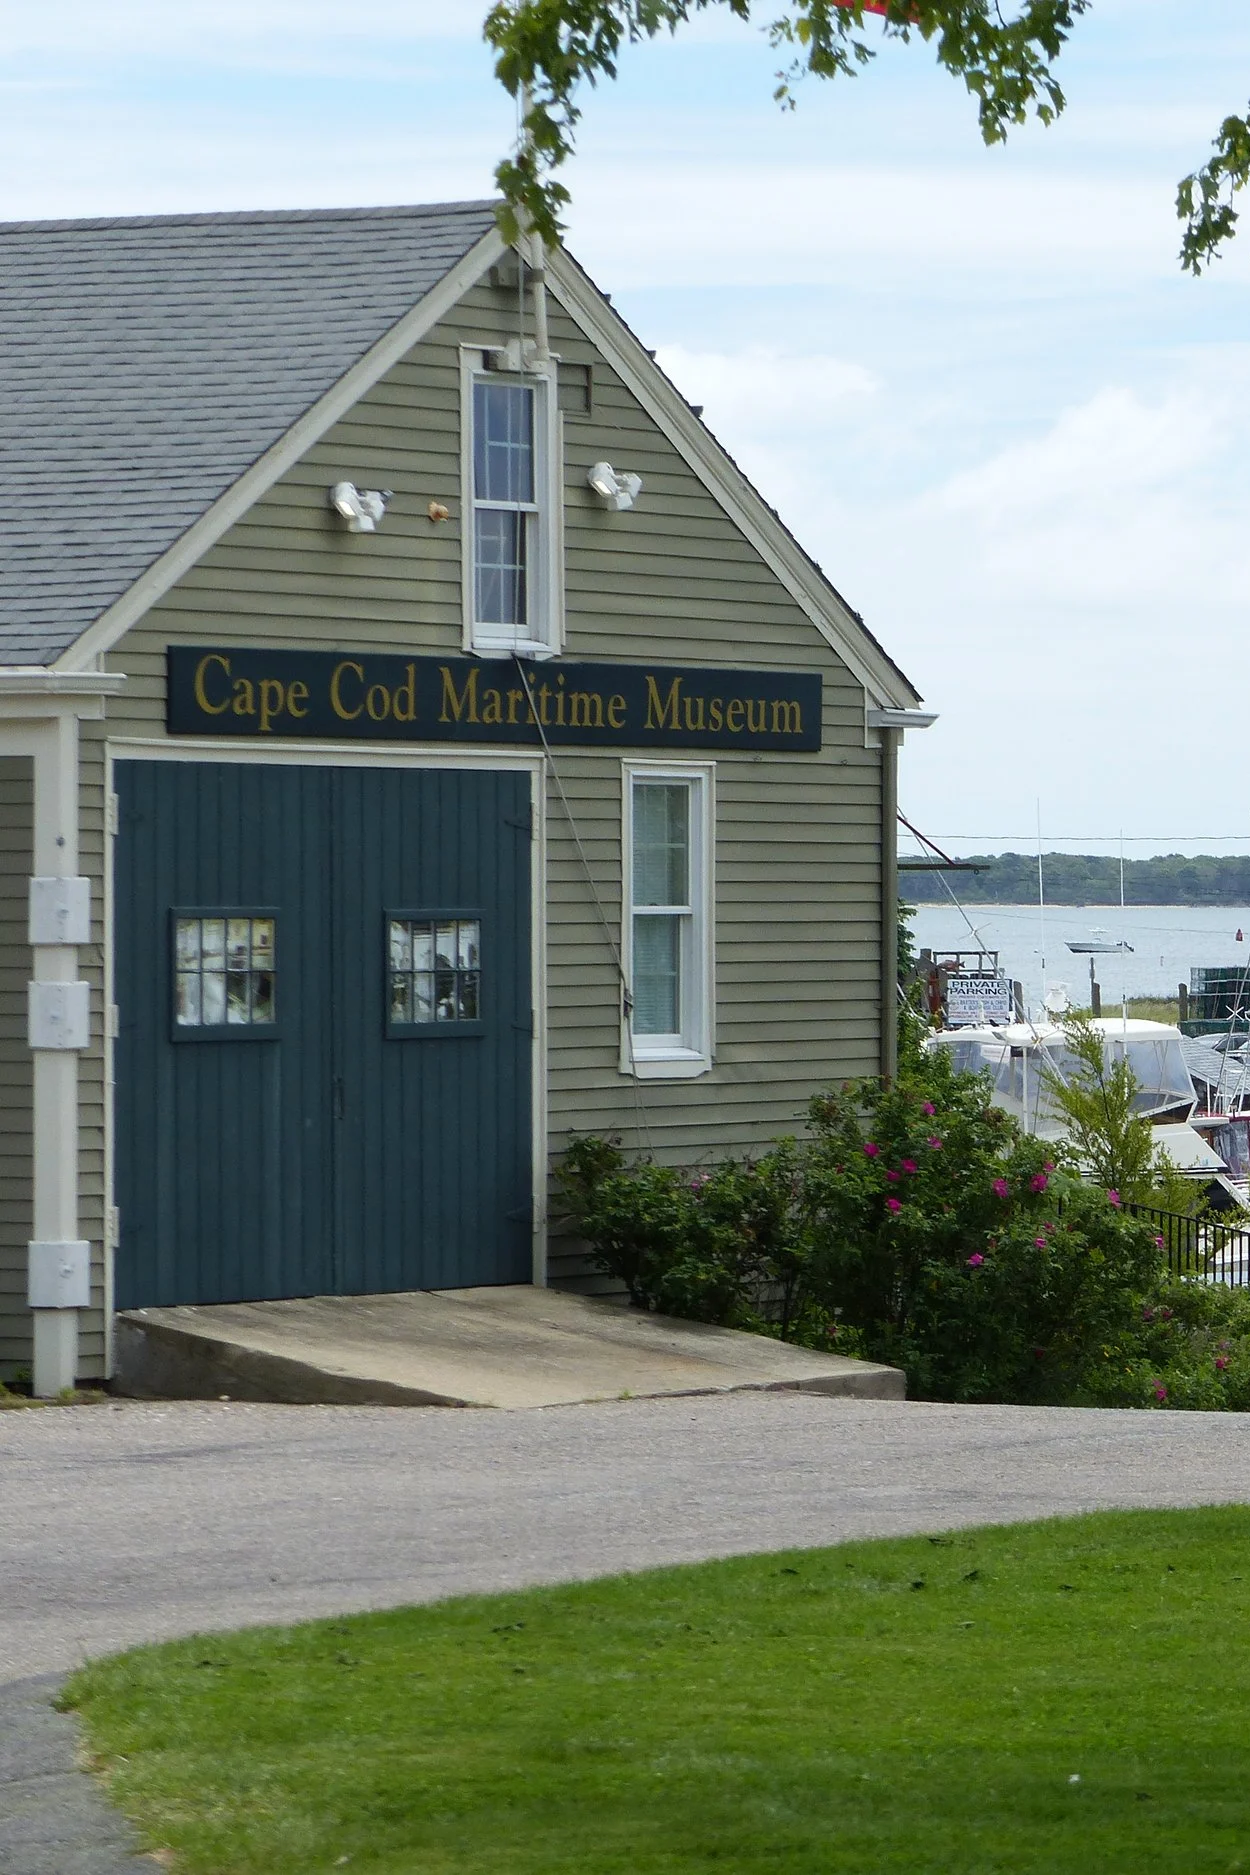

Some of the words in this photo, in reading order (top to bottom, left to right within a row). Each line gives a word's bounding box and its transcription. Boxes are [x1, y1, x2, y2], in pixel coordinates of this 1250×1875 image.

[194, 653, 309, 731] Cape
[330, 661, 417, 722] Cod
[438, 667, 626, 728] Maritime
[644, 675, 804, 733] Museum
